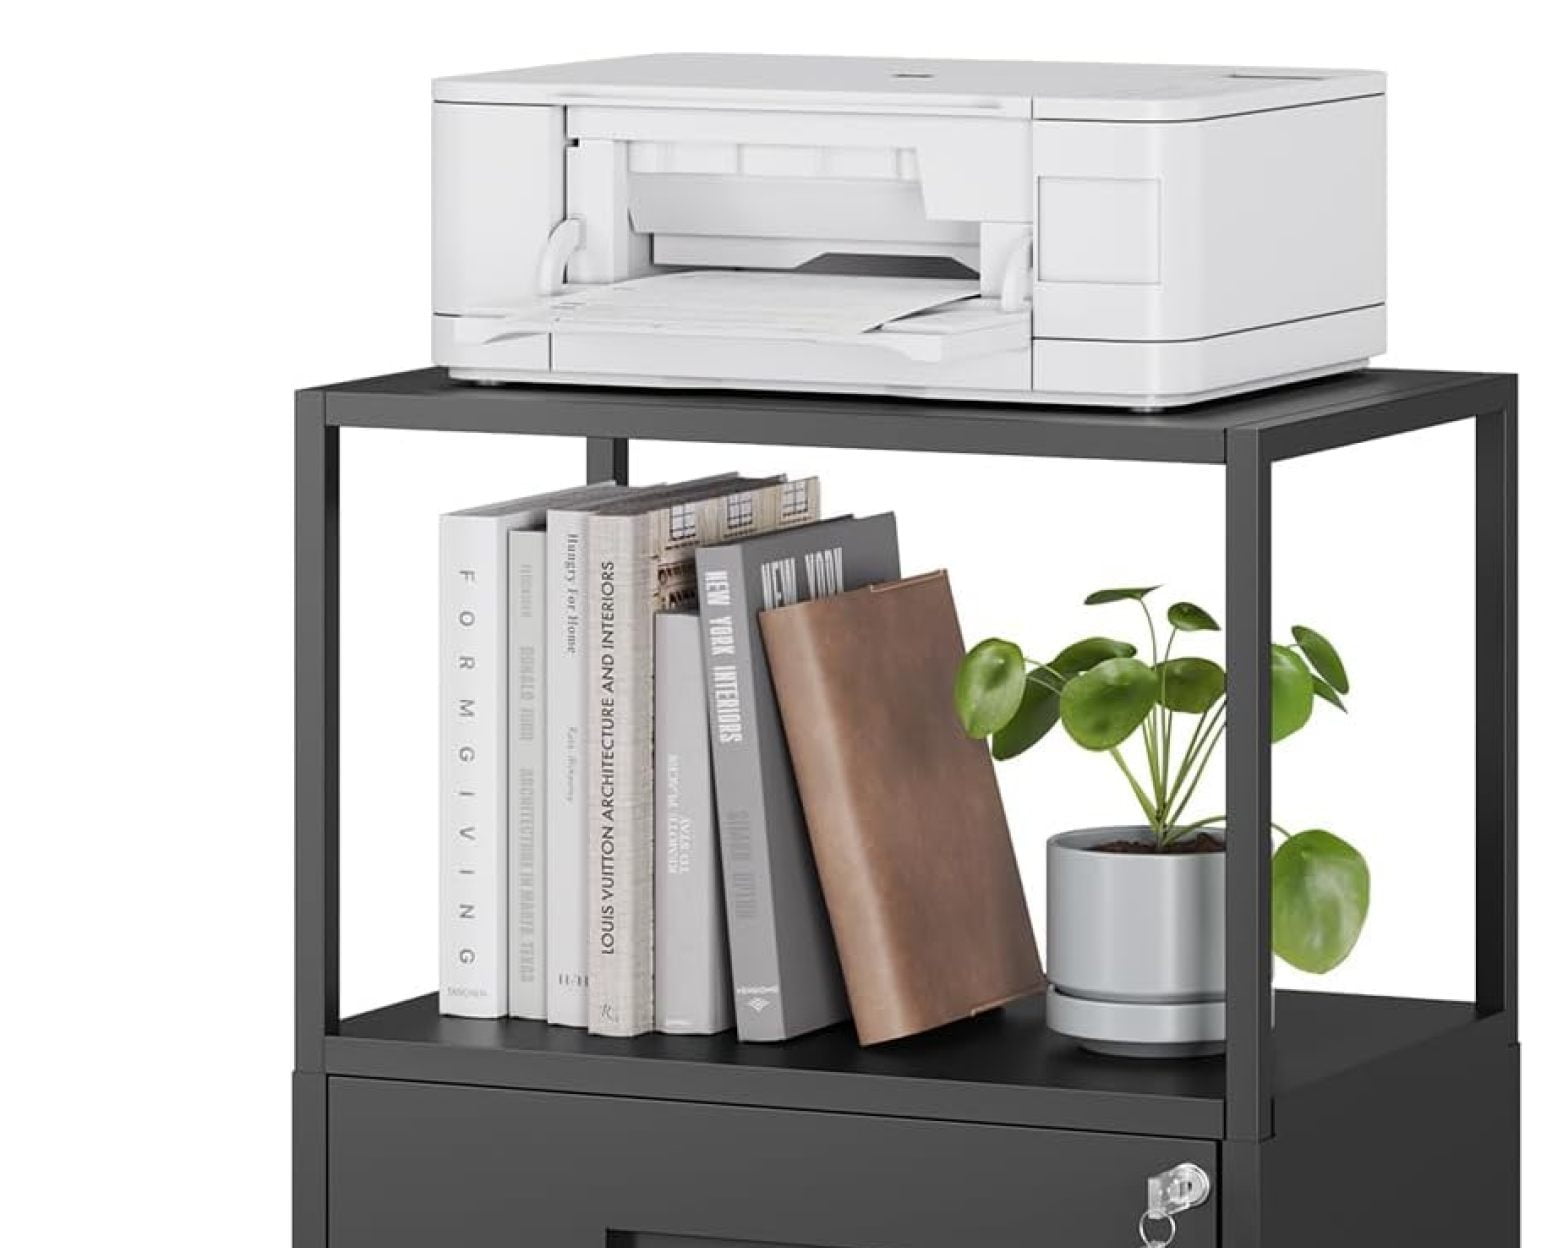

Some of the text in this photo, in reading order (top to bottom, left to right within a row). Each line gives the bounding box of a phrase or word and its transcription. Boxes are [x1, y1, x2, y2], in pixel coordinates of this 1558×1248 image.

[565, 533, 579, 655] Hungry For Home
[704, 571, 743, 744] NEW YORK INTERIORS
[458, 568, 476, 966] FORMGIVING
[600, 560, 615, 956] LOUIS VUITTON ARCHITECTURE AND INTERIORS
